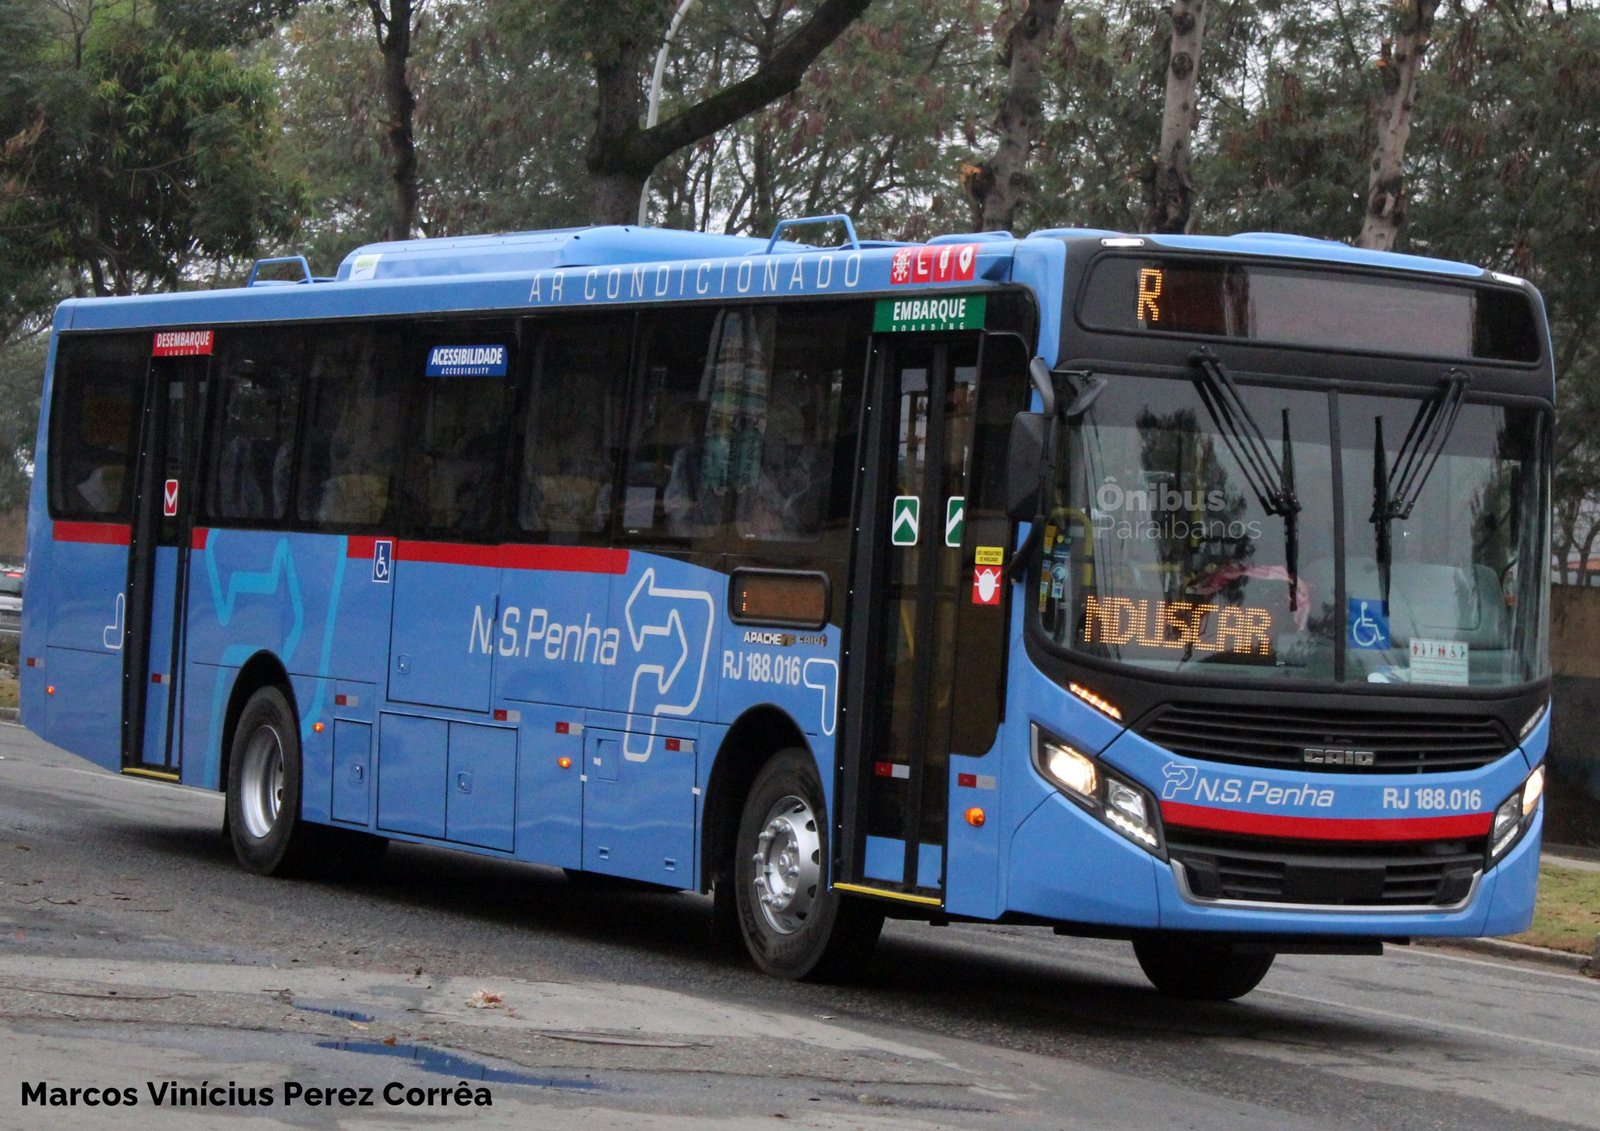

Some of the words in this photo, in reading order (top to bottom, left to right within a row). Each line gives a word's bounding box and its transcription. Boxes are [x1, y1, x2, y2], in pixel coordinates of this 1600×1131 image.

[528, 271, 565, 303] AR
[584, 253, 862, 301] CONDICIONADO
[1137, 268, 1162, 321] R
[893, 298, 967, 322] EMBARQUE
[156, 331, 211, 350] DESEMBARQUE
[431, 347, 503, 366] ACESSIBILIDADE
[441, 367, 489, 375] ACCESSIBILITY
[524, 607, 620, 665] Penha
[743, 631, 781, 646] APACHE
[722, 650, 743, 680] RJ
[746, 652, 801, 686] 188.016
[1246, 780, 1335, 807] Penha
[1382, 787, 1410, 809] RJ
[1414, 788, 1482, 811] 188.016
